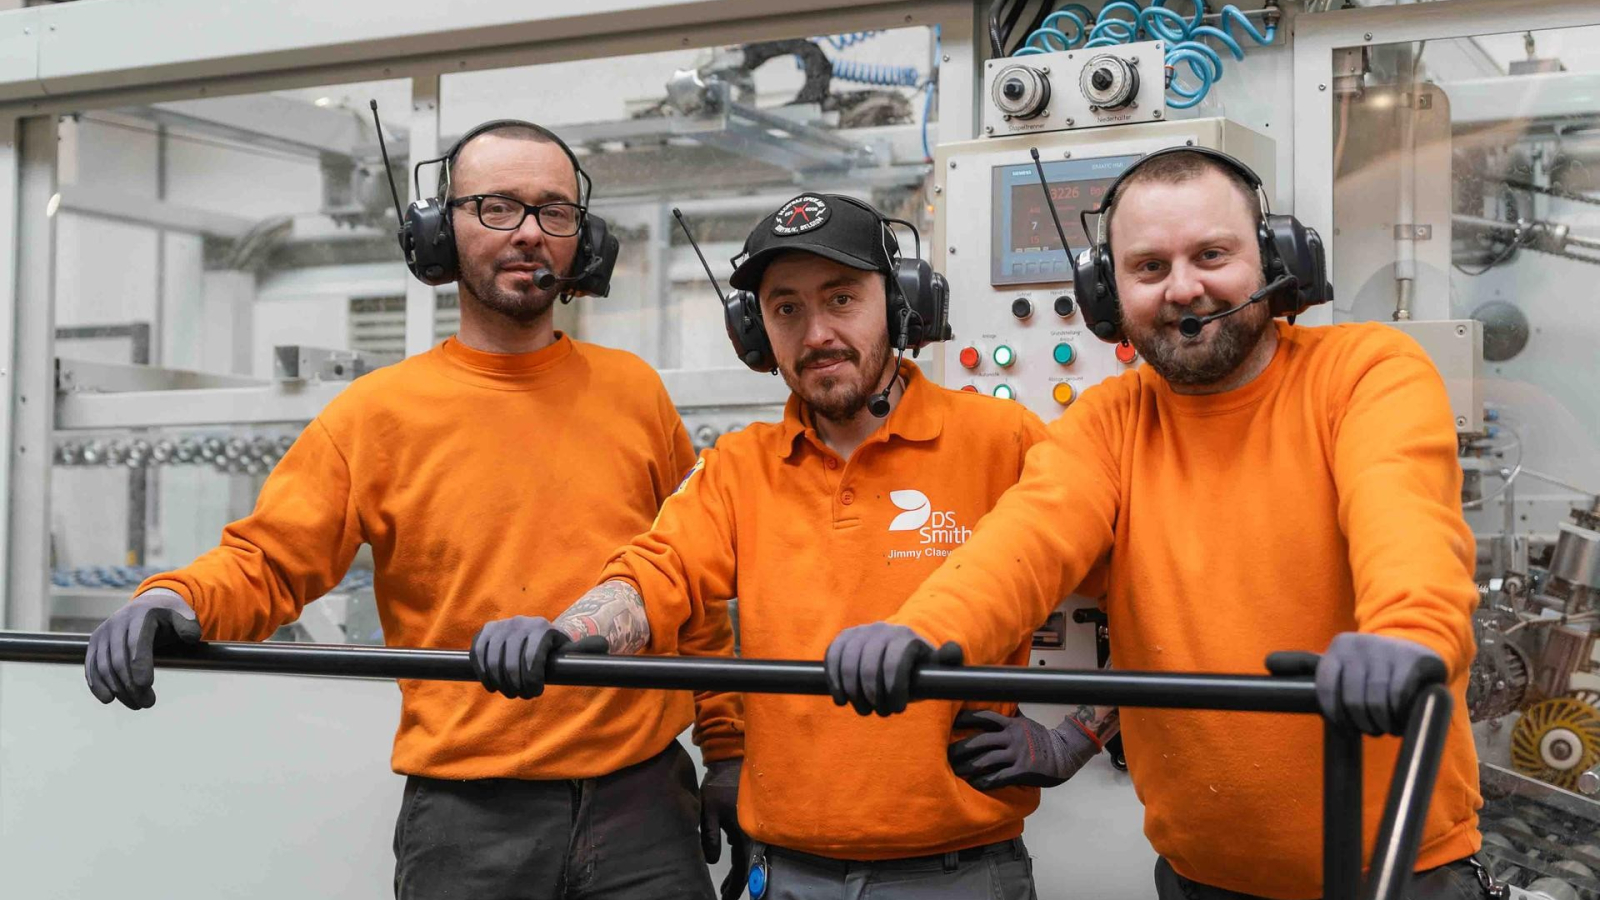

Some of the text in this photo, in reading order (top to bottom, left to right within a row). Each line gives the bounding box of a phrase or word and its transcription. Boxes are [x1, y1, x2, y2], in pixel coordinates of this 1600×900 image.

[931, 511, 956, 529] DS
[919, 525, 972, 544] Smith
[888, 549, 922, 560] Jimmy
